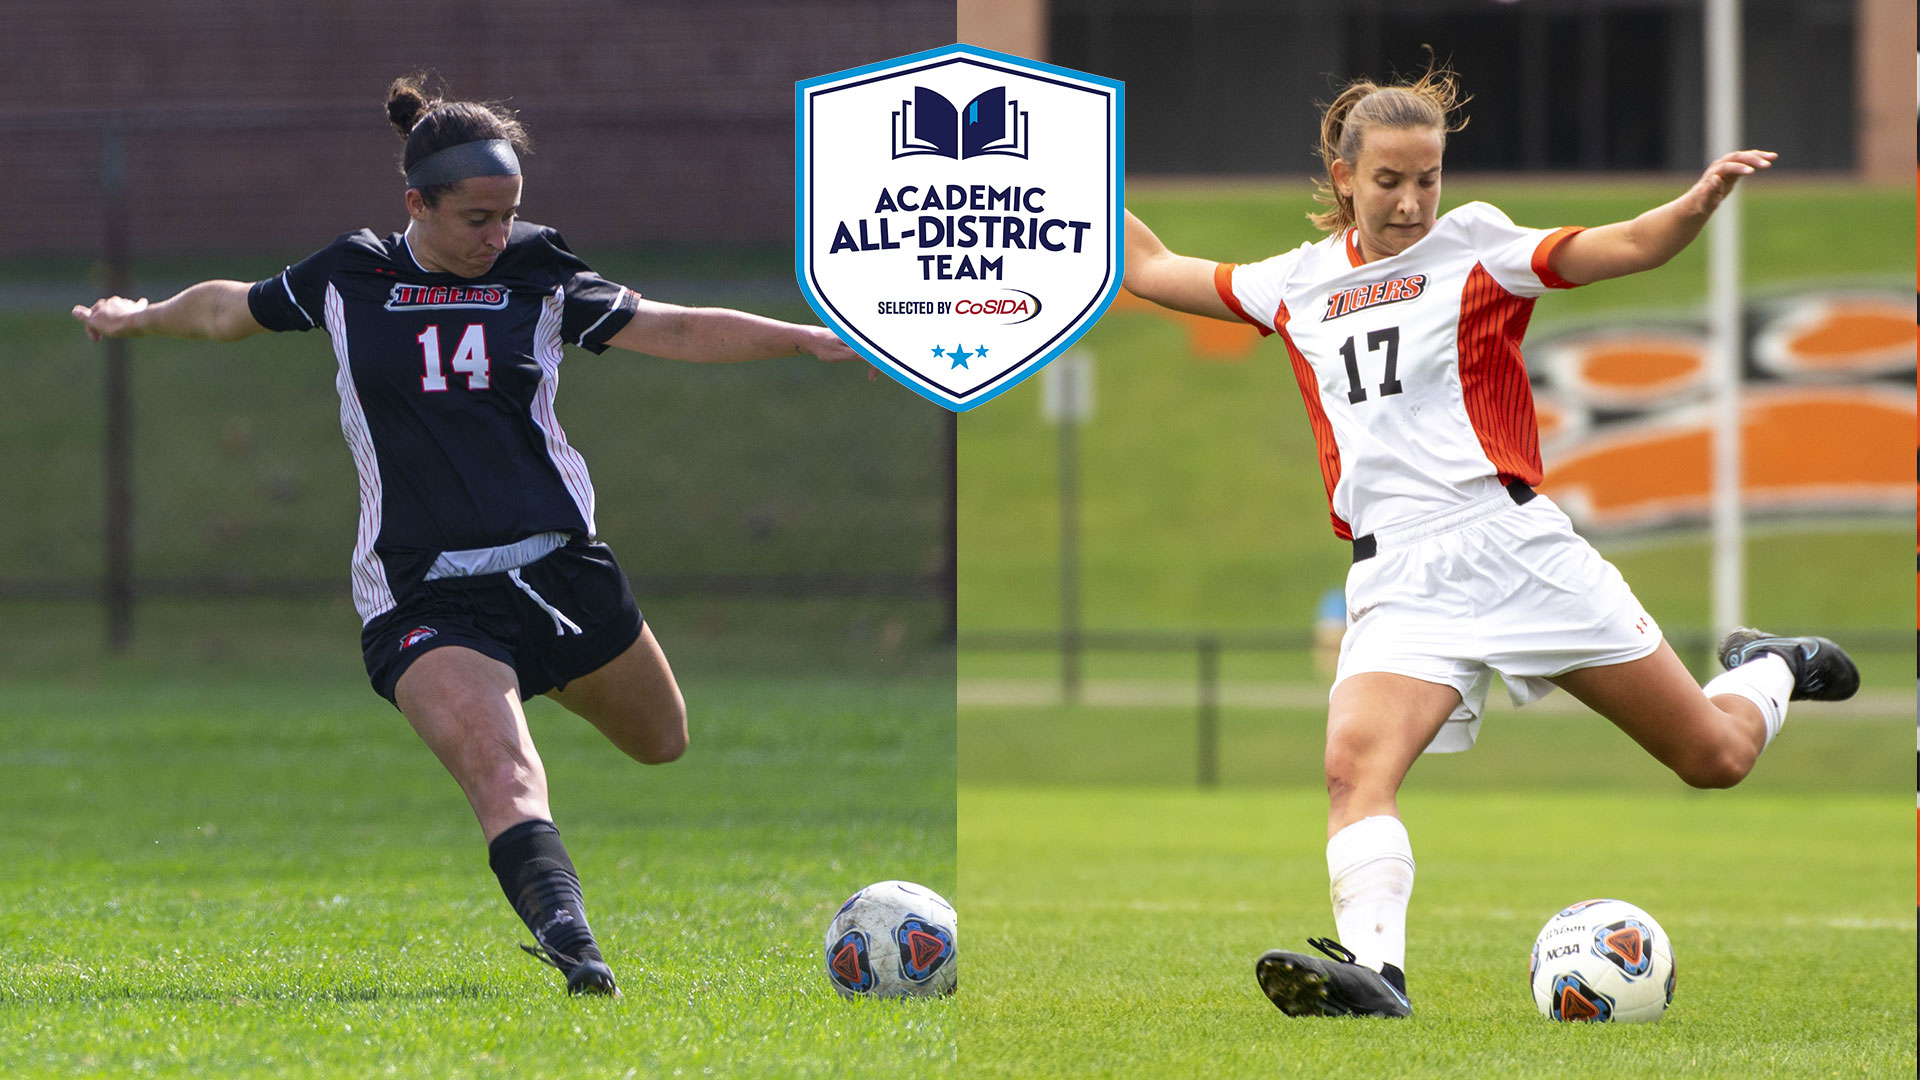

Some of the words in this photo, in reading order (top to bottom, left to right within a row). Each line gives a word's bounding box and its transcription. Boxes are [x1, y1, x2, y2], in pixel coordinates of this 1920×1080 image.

[394, 284, 505, 307] TIGERS
[1323, 274, 1427, 321] TIGERS
[416, 322, 492, 393] 14
[1338, 326, 1404, 406] 17
[1545, 943, 1580, 962] NCAA
